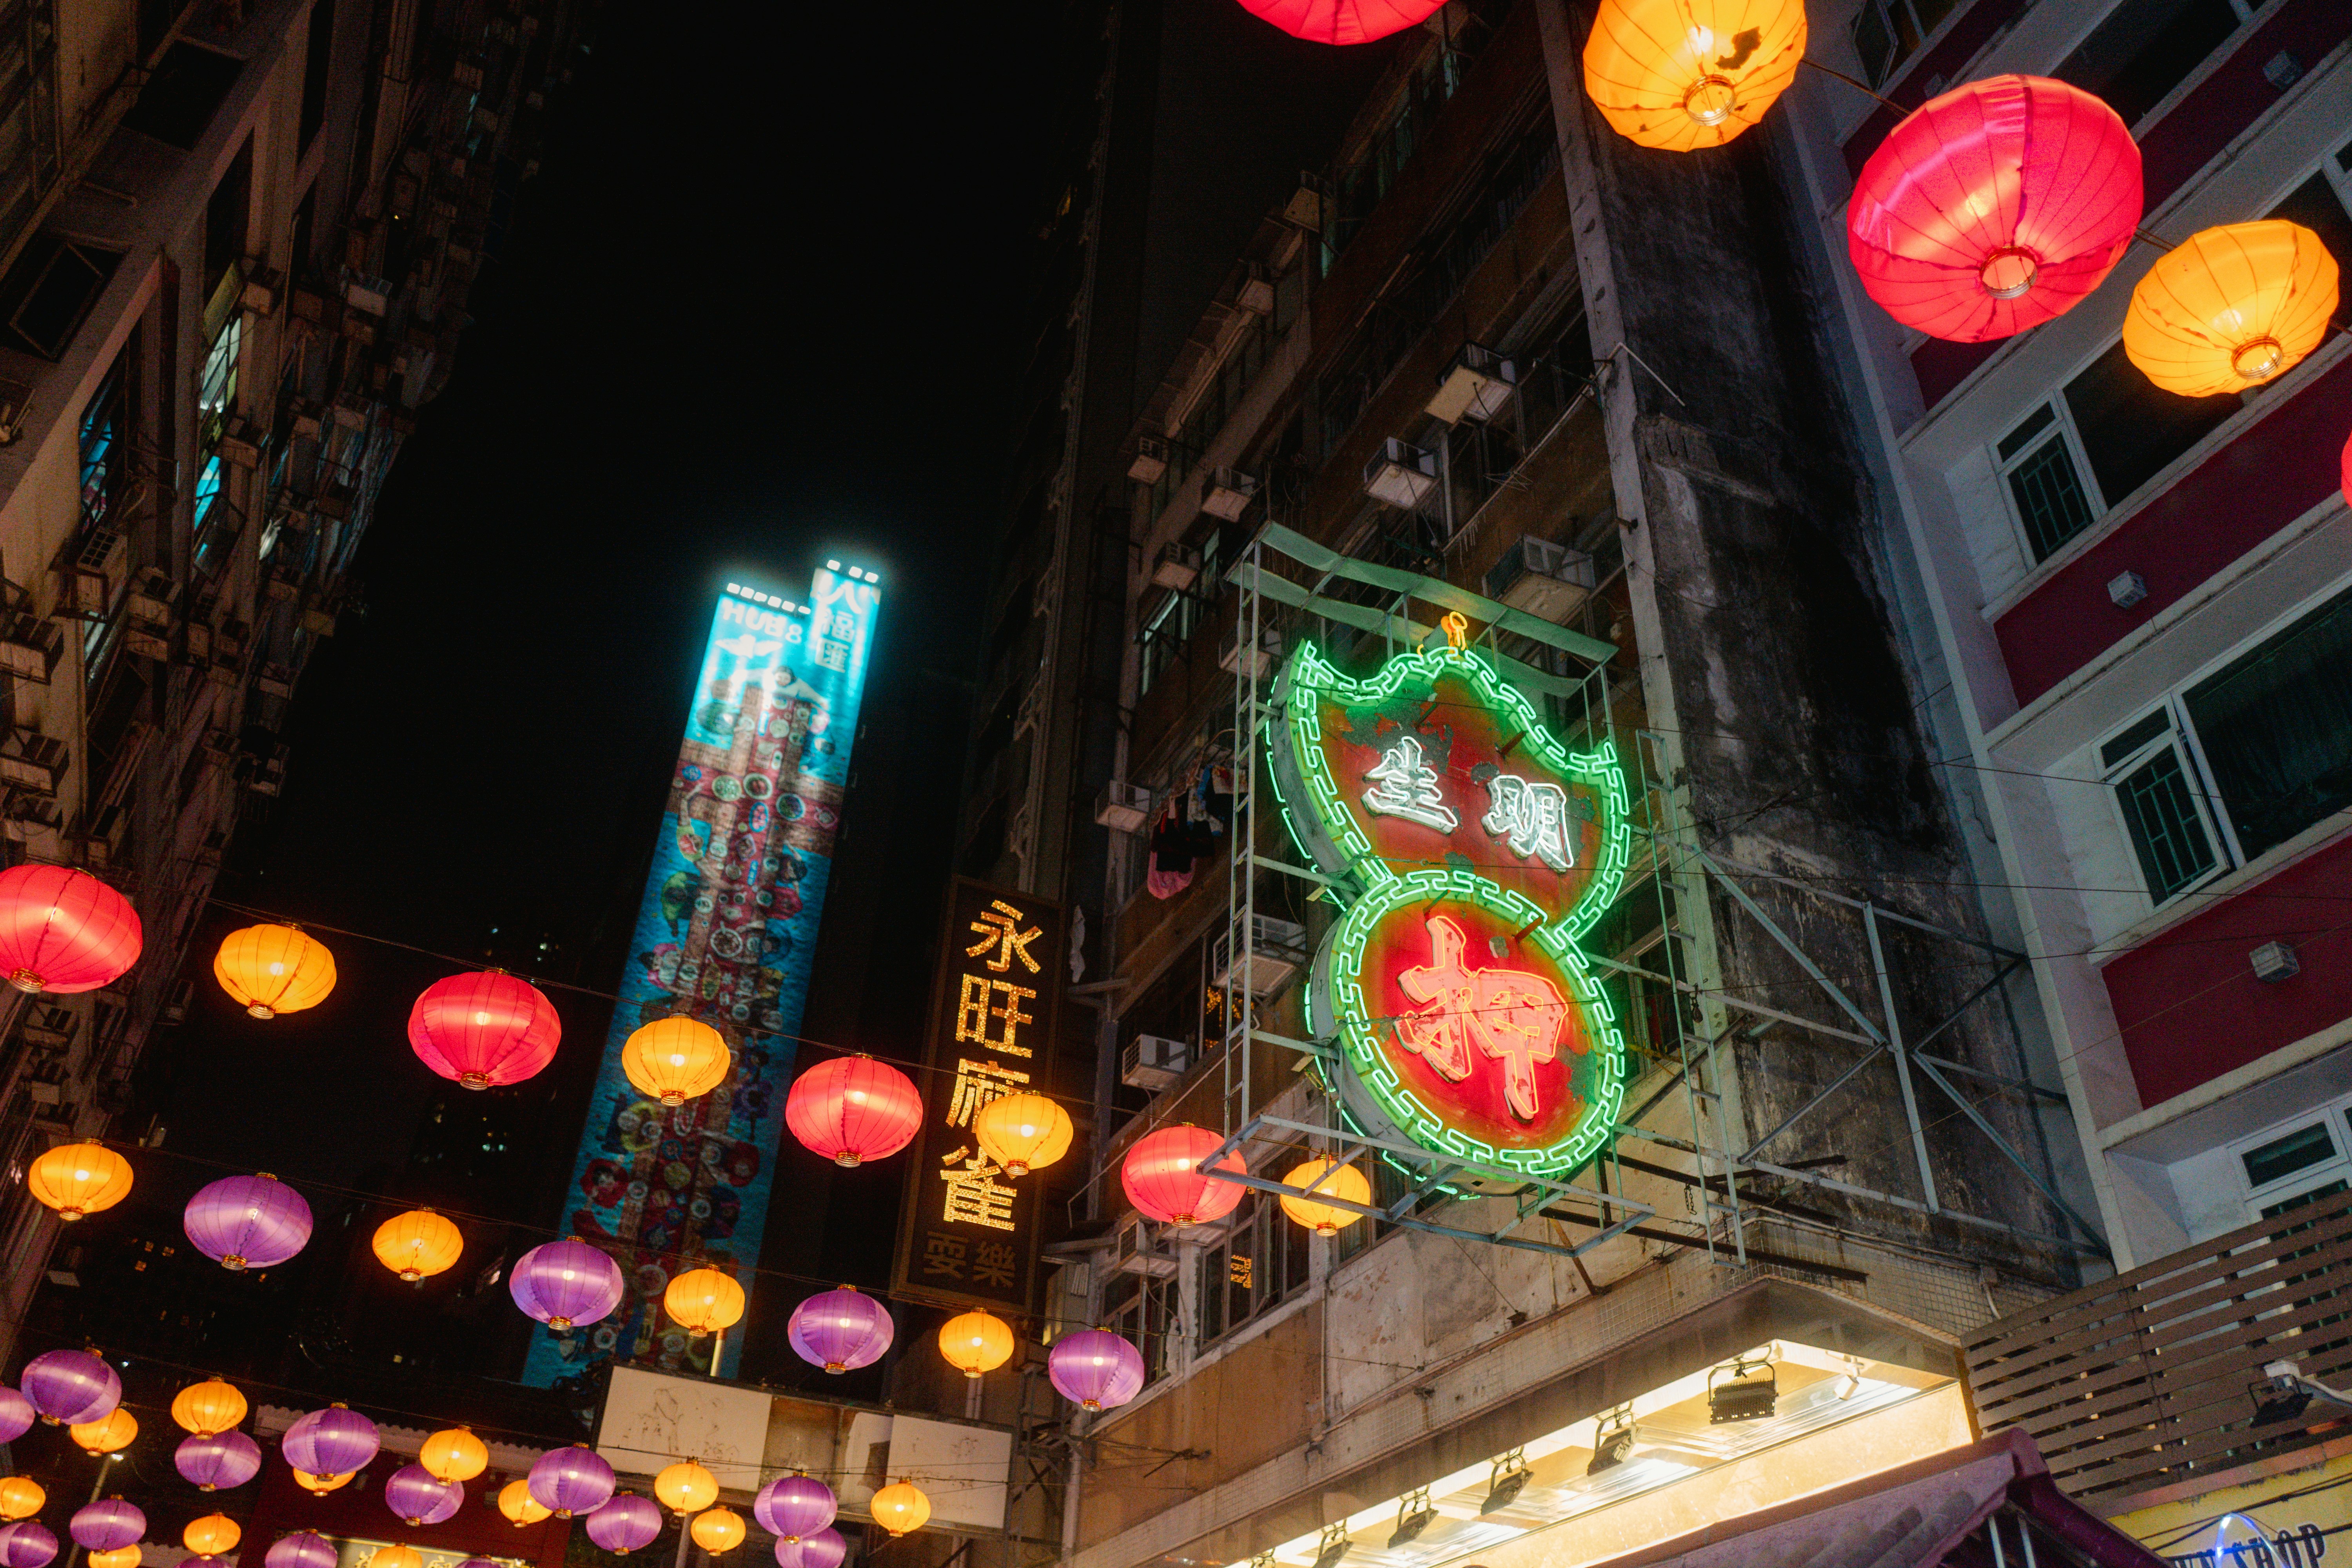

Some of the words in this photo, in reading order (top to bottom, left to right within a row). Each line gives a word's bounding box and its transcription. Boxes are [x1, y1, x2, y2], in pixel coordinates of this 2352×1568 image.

[722, 597, 786, 637] HUB
[785, 624, 802, 644] 8
[1395, 915, 1568, 1121] 押
